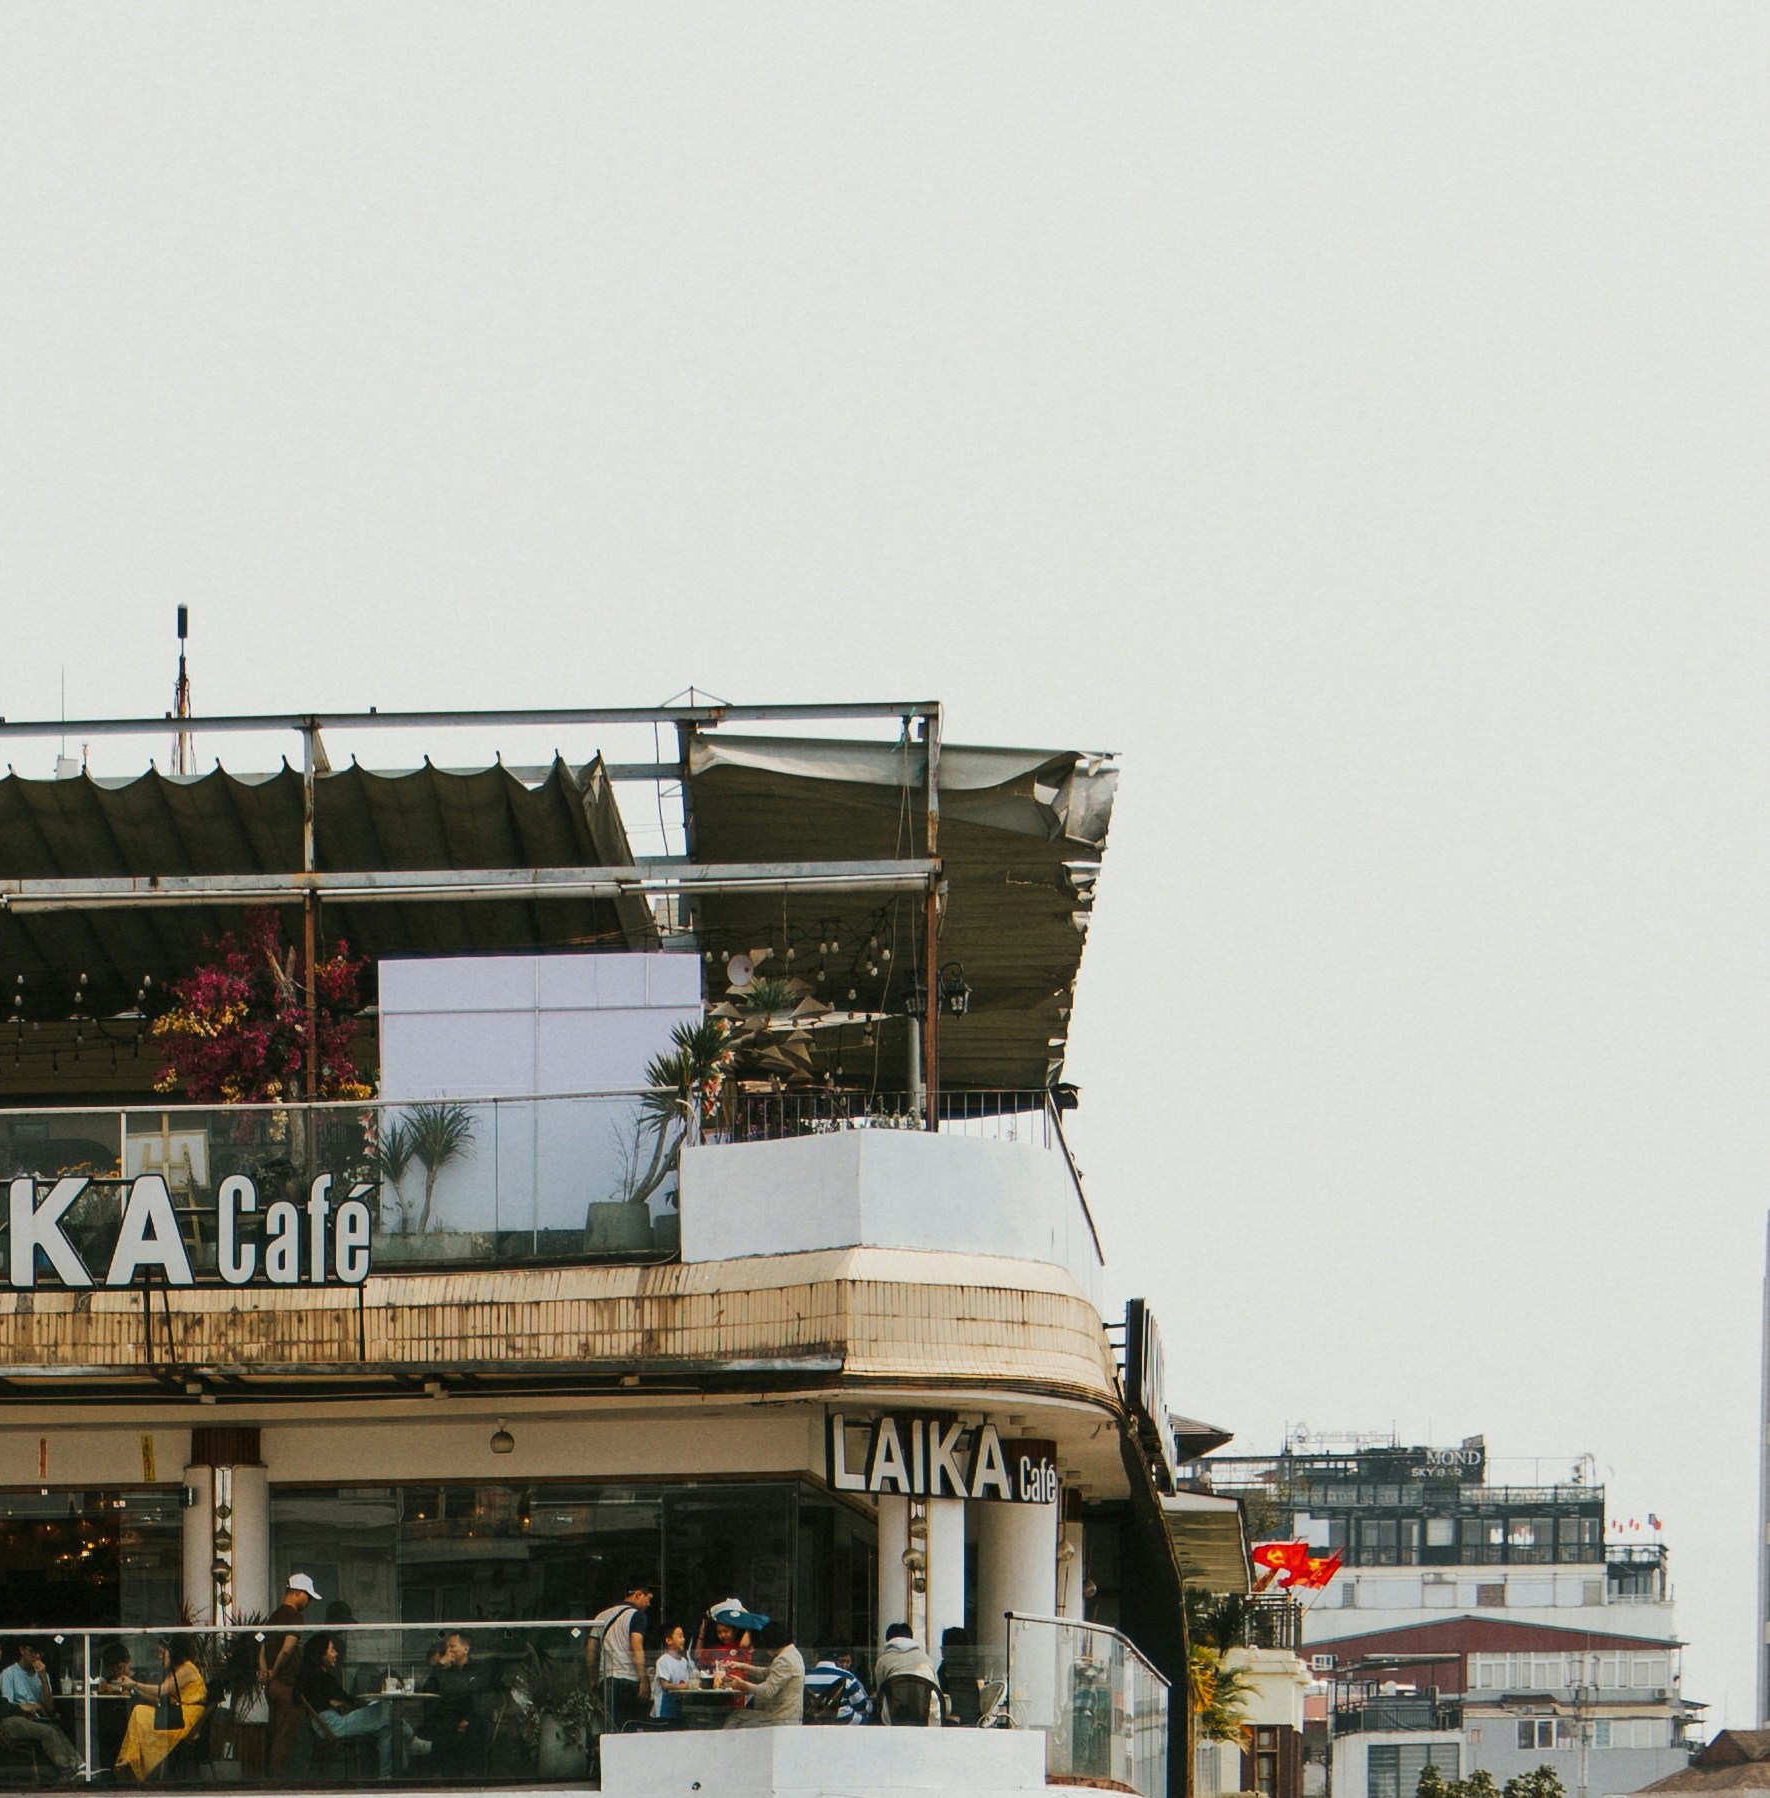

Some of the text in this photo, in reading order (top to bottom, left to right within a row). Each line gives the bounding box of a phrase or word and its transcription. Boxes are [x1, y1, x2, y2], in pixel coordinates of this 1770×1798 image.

[217, 1173, 382, 1287] Café
[833, 1413, 1057, 1503] LAIKA Café
[1411, 1468, 1437, 1478] SKY
